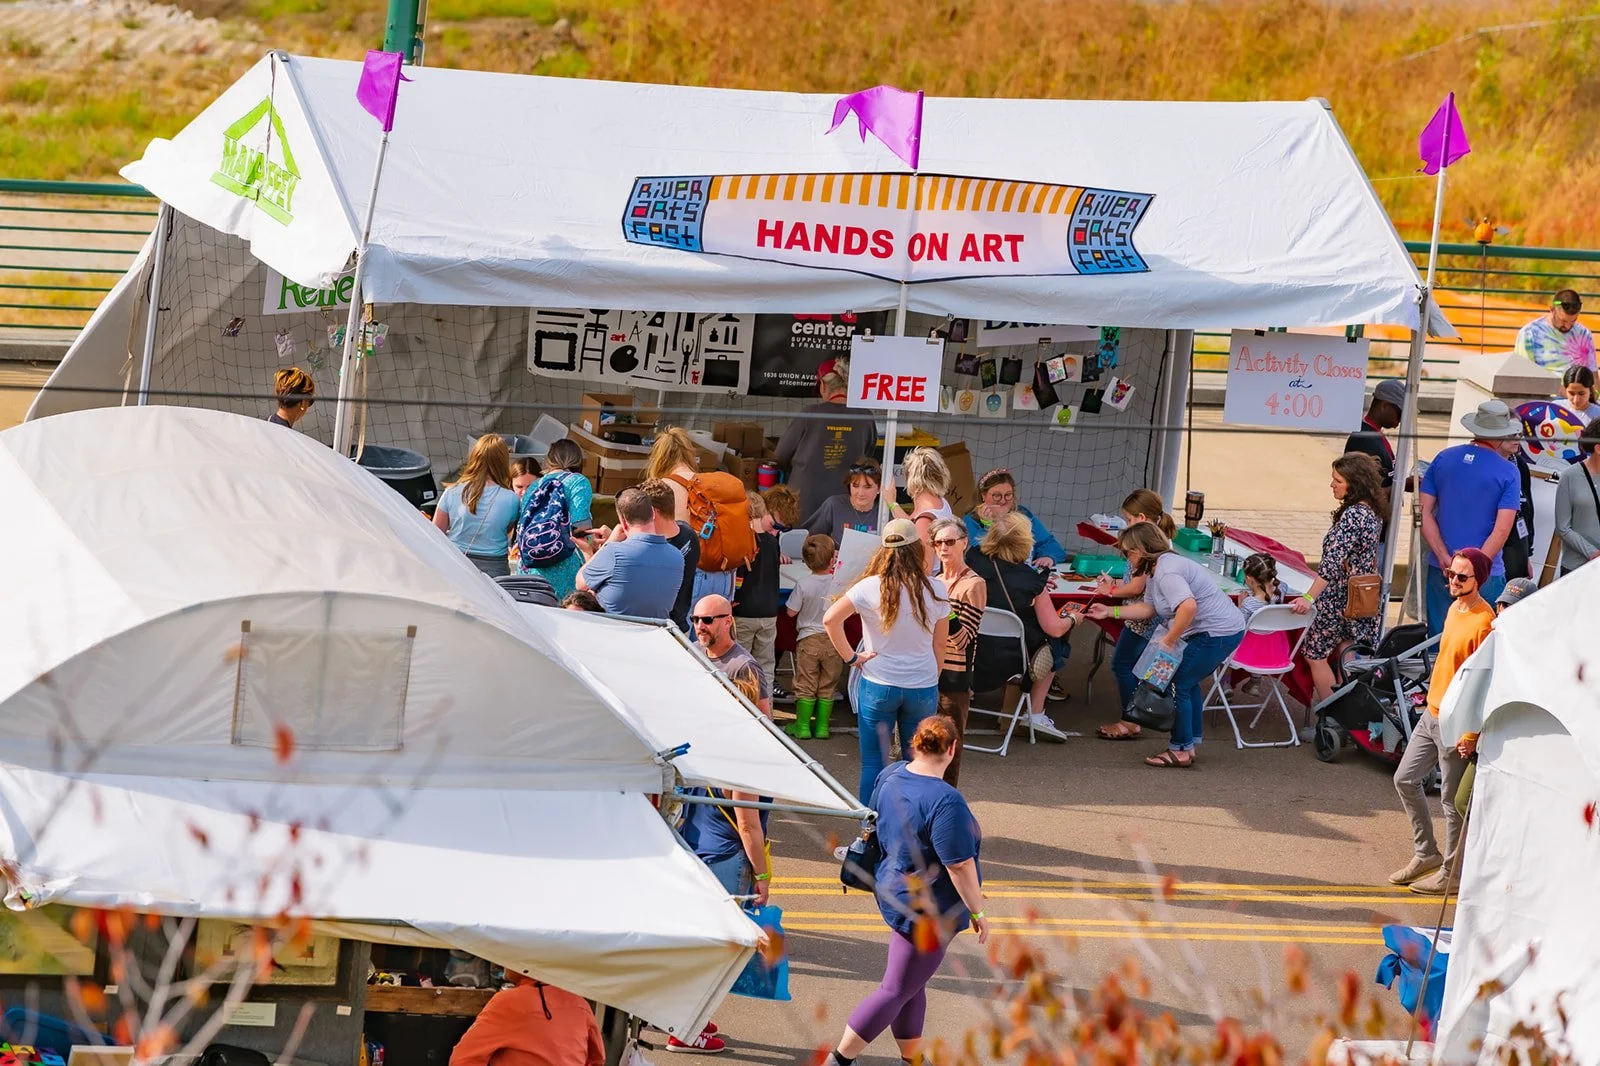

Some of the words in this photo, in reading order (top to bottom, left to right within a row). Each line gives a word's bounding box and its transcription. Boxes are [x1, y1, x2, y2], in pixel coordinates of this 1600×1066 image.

[756, 218, 895, 259] HANDS
[907, 232, 949, 263] ON
[958, 233, 1025, 263] ART
[791, 321, 856, 338] center
[610, 333, 627, 342] art
[791, 336, 823, 344] SUPPLY
[798, 342, 827, 350] FRAME
[1234, 345, 1309, 377] Activity
[1313, 354, 1364, 380] Closes
[778, 372, 800, 380] UNION
[1288, 375, 1313, 389] at
[860, 372, 928, 403] FREE
[1264, 392, 1324, 418] 4:00
